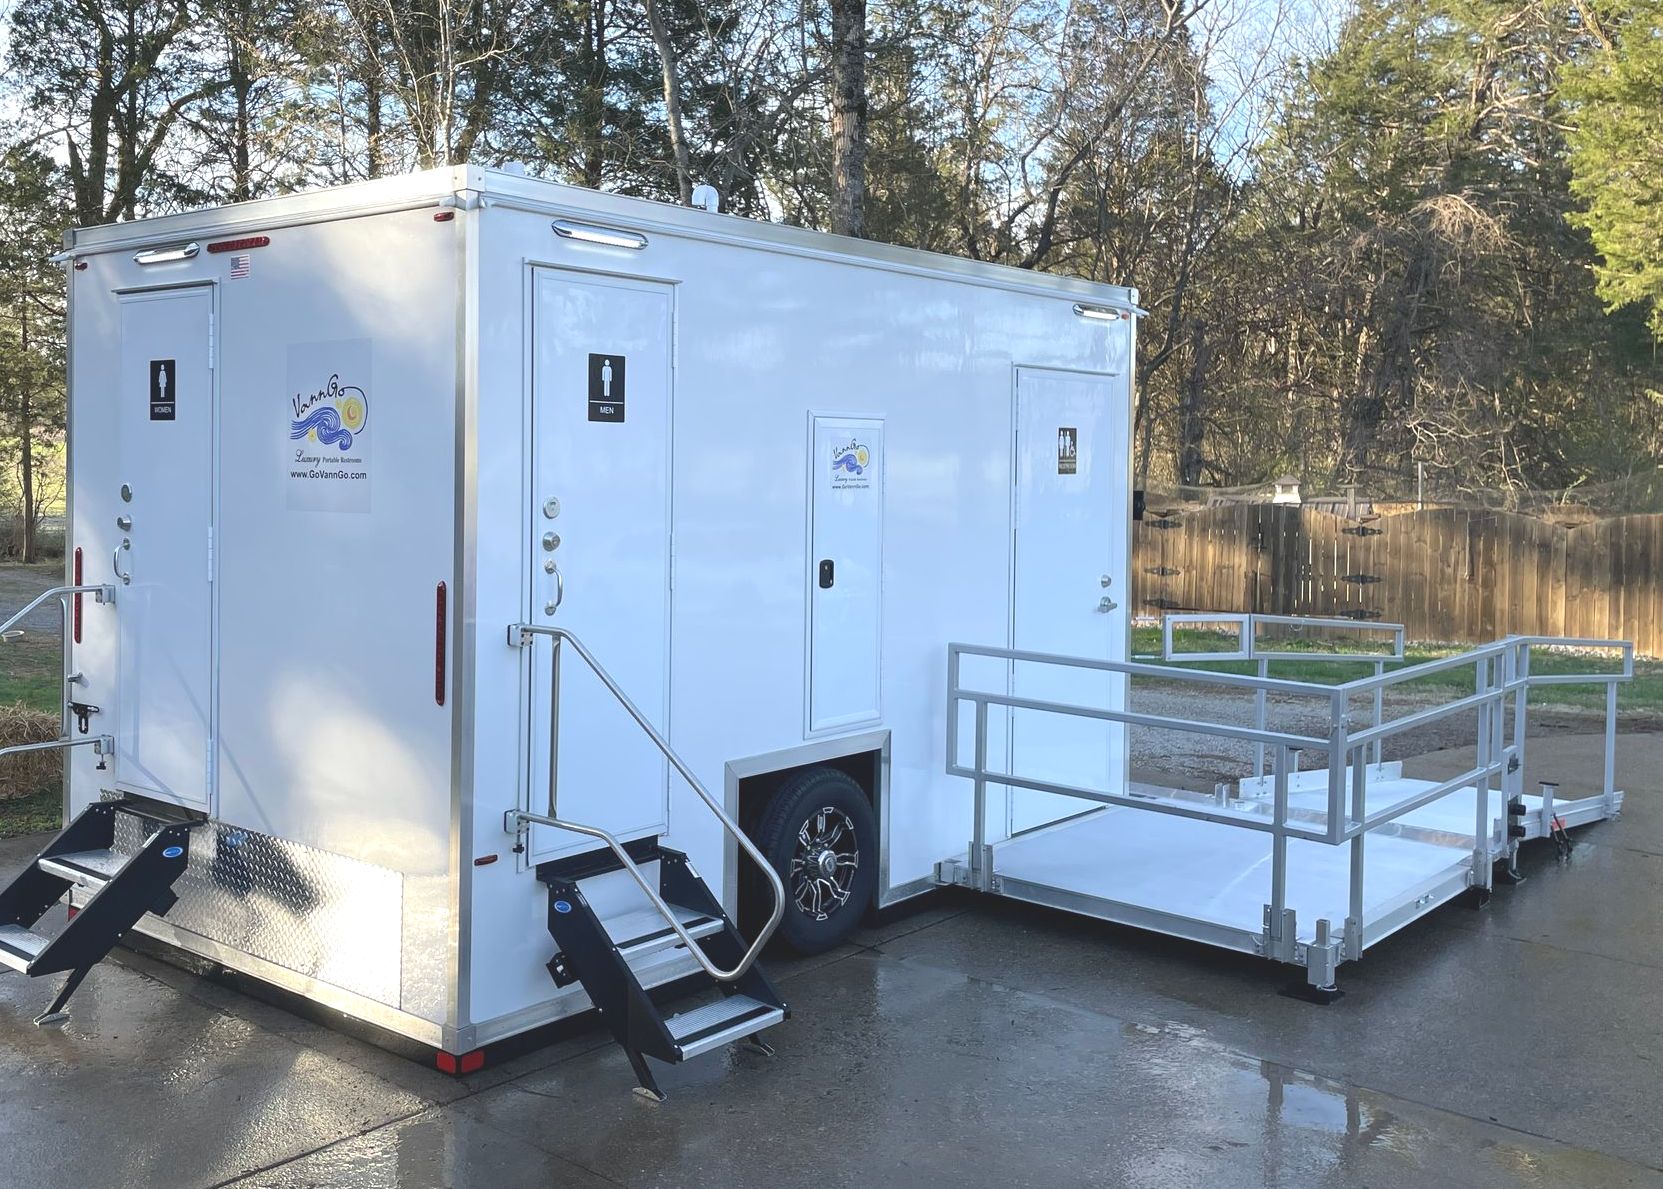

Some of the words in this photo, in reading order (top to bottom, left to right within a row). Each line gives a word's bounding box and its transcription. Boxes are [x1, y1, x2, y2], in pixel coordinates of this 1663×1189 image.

[292, 373, 350, 420] VannGo
[154, 406, 172, 414] WOMEN
[599, 406, 615, 414] MEN
[295, 448, 321, 468] Luxury
[290, 469, 368, 480] www.GoVannGo.com
